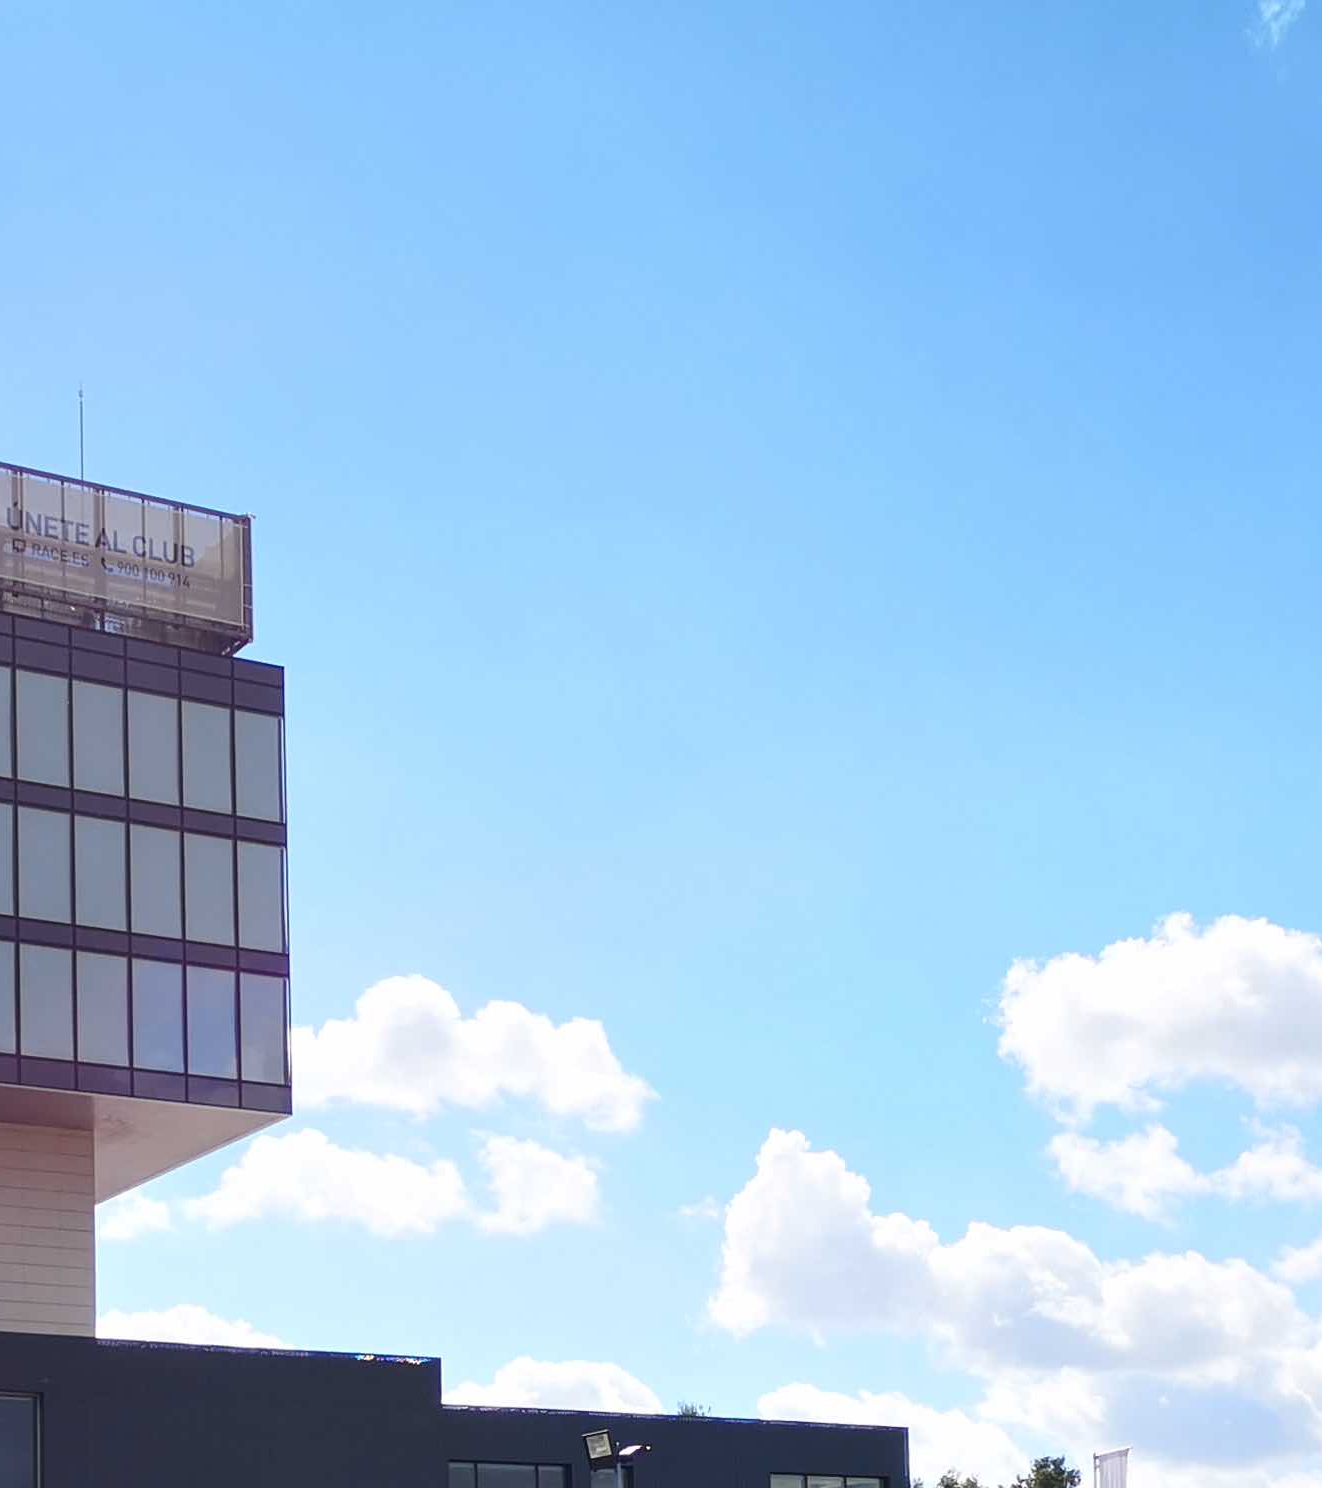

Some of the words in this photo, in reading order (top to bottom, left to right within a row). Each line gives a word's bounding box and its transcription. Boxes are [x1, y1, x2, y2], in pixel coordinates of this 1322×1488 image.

[6, 501, 89, 546] ÚNETE
[95, 528, 126, 555] AL
[133, 536, 195, 568] CLUB
[32, 542, 89, 567] RACE.ES
[117, 560, 140, 577] 900
